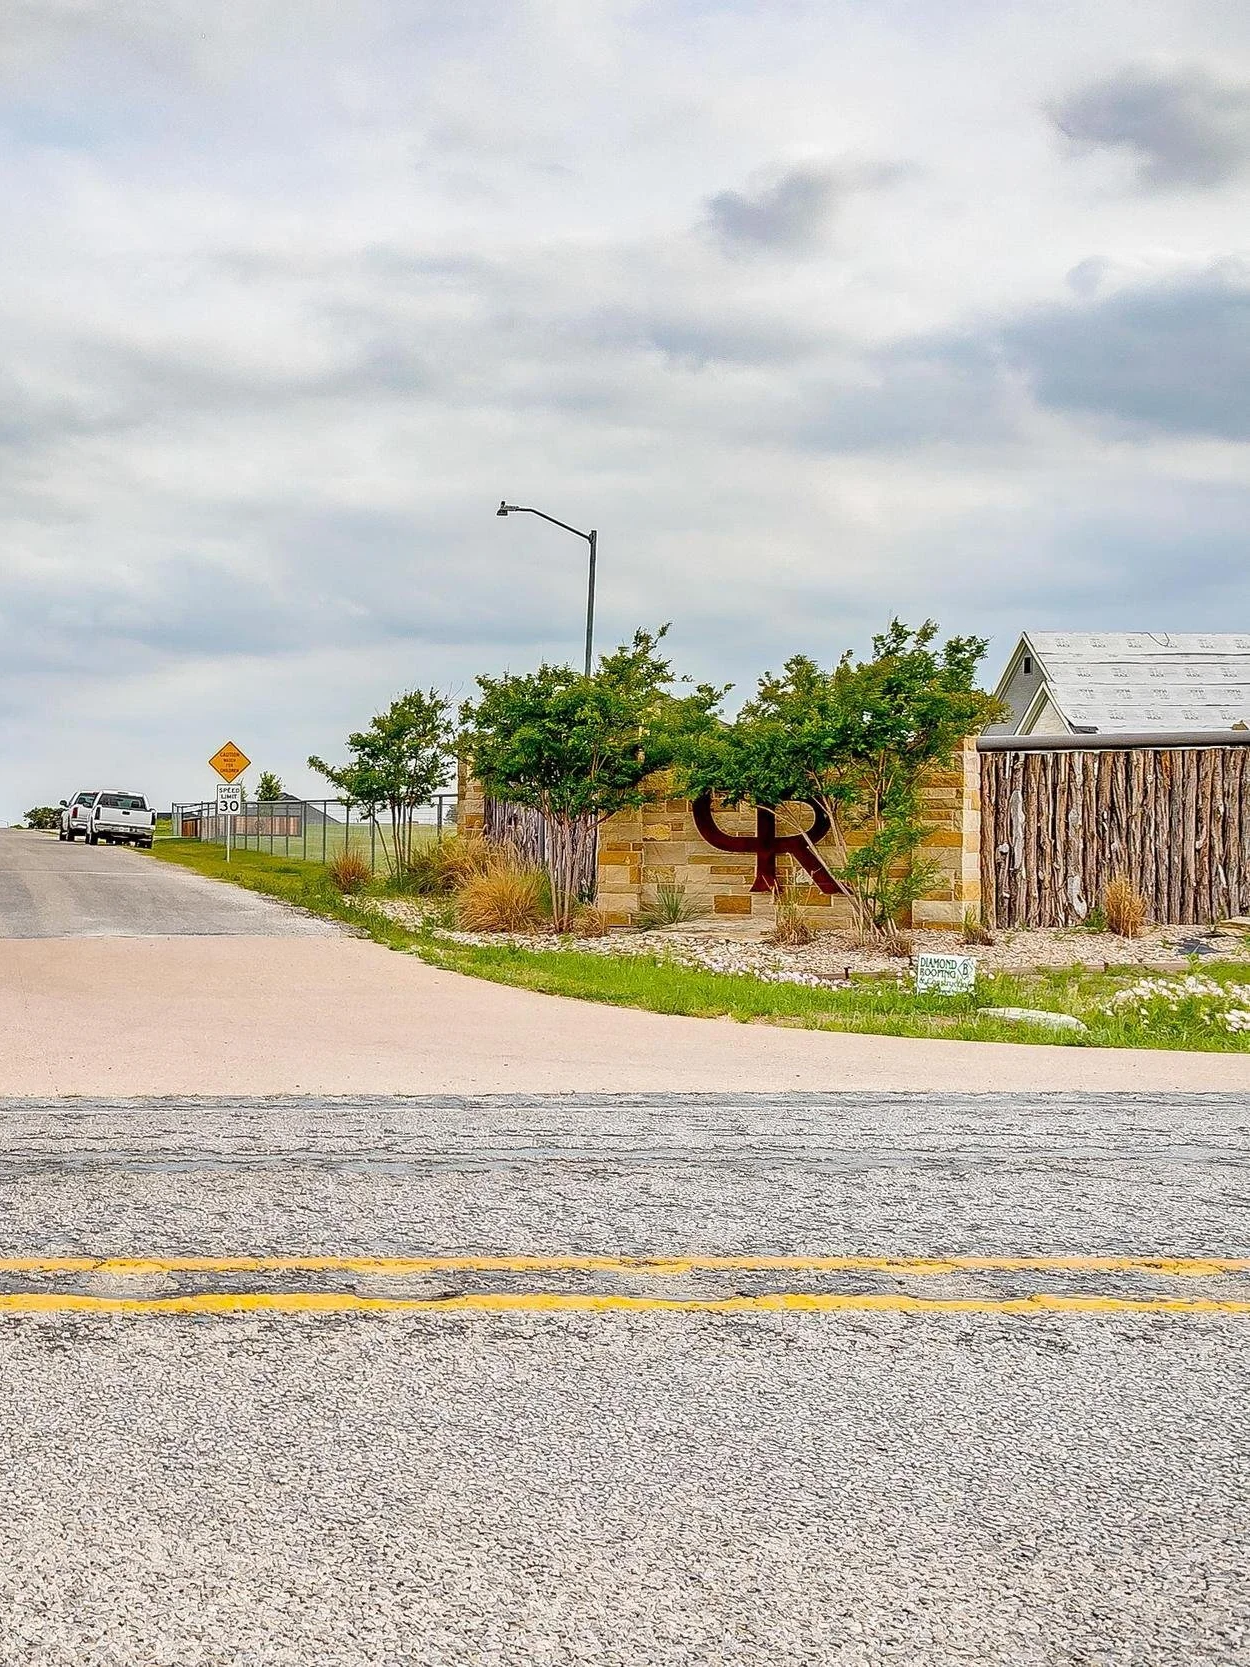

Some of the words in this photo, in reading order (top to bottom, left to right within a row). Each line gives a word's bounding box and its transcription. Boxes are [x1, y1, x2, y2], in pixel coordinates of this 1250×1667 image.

[219, 800, 239, 812] 30
[920, 957, 958, 970] DIAMOND
[920, 968, 956, 979] ROOFING
